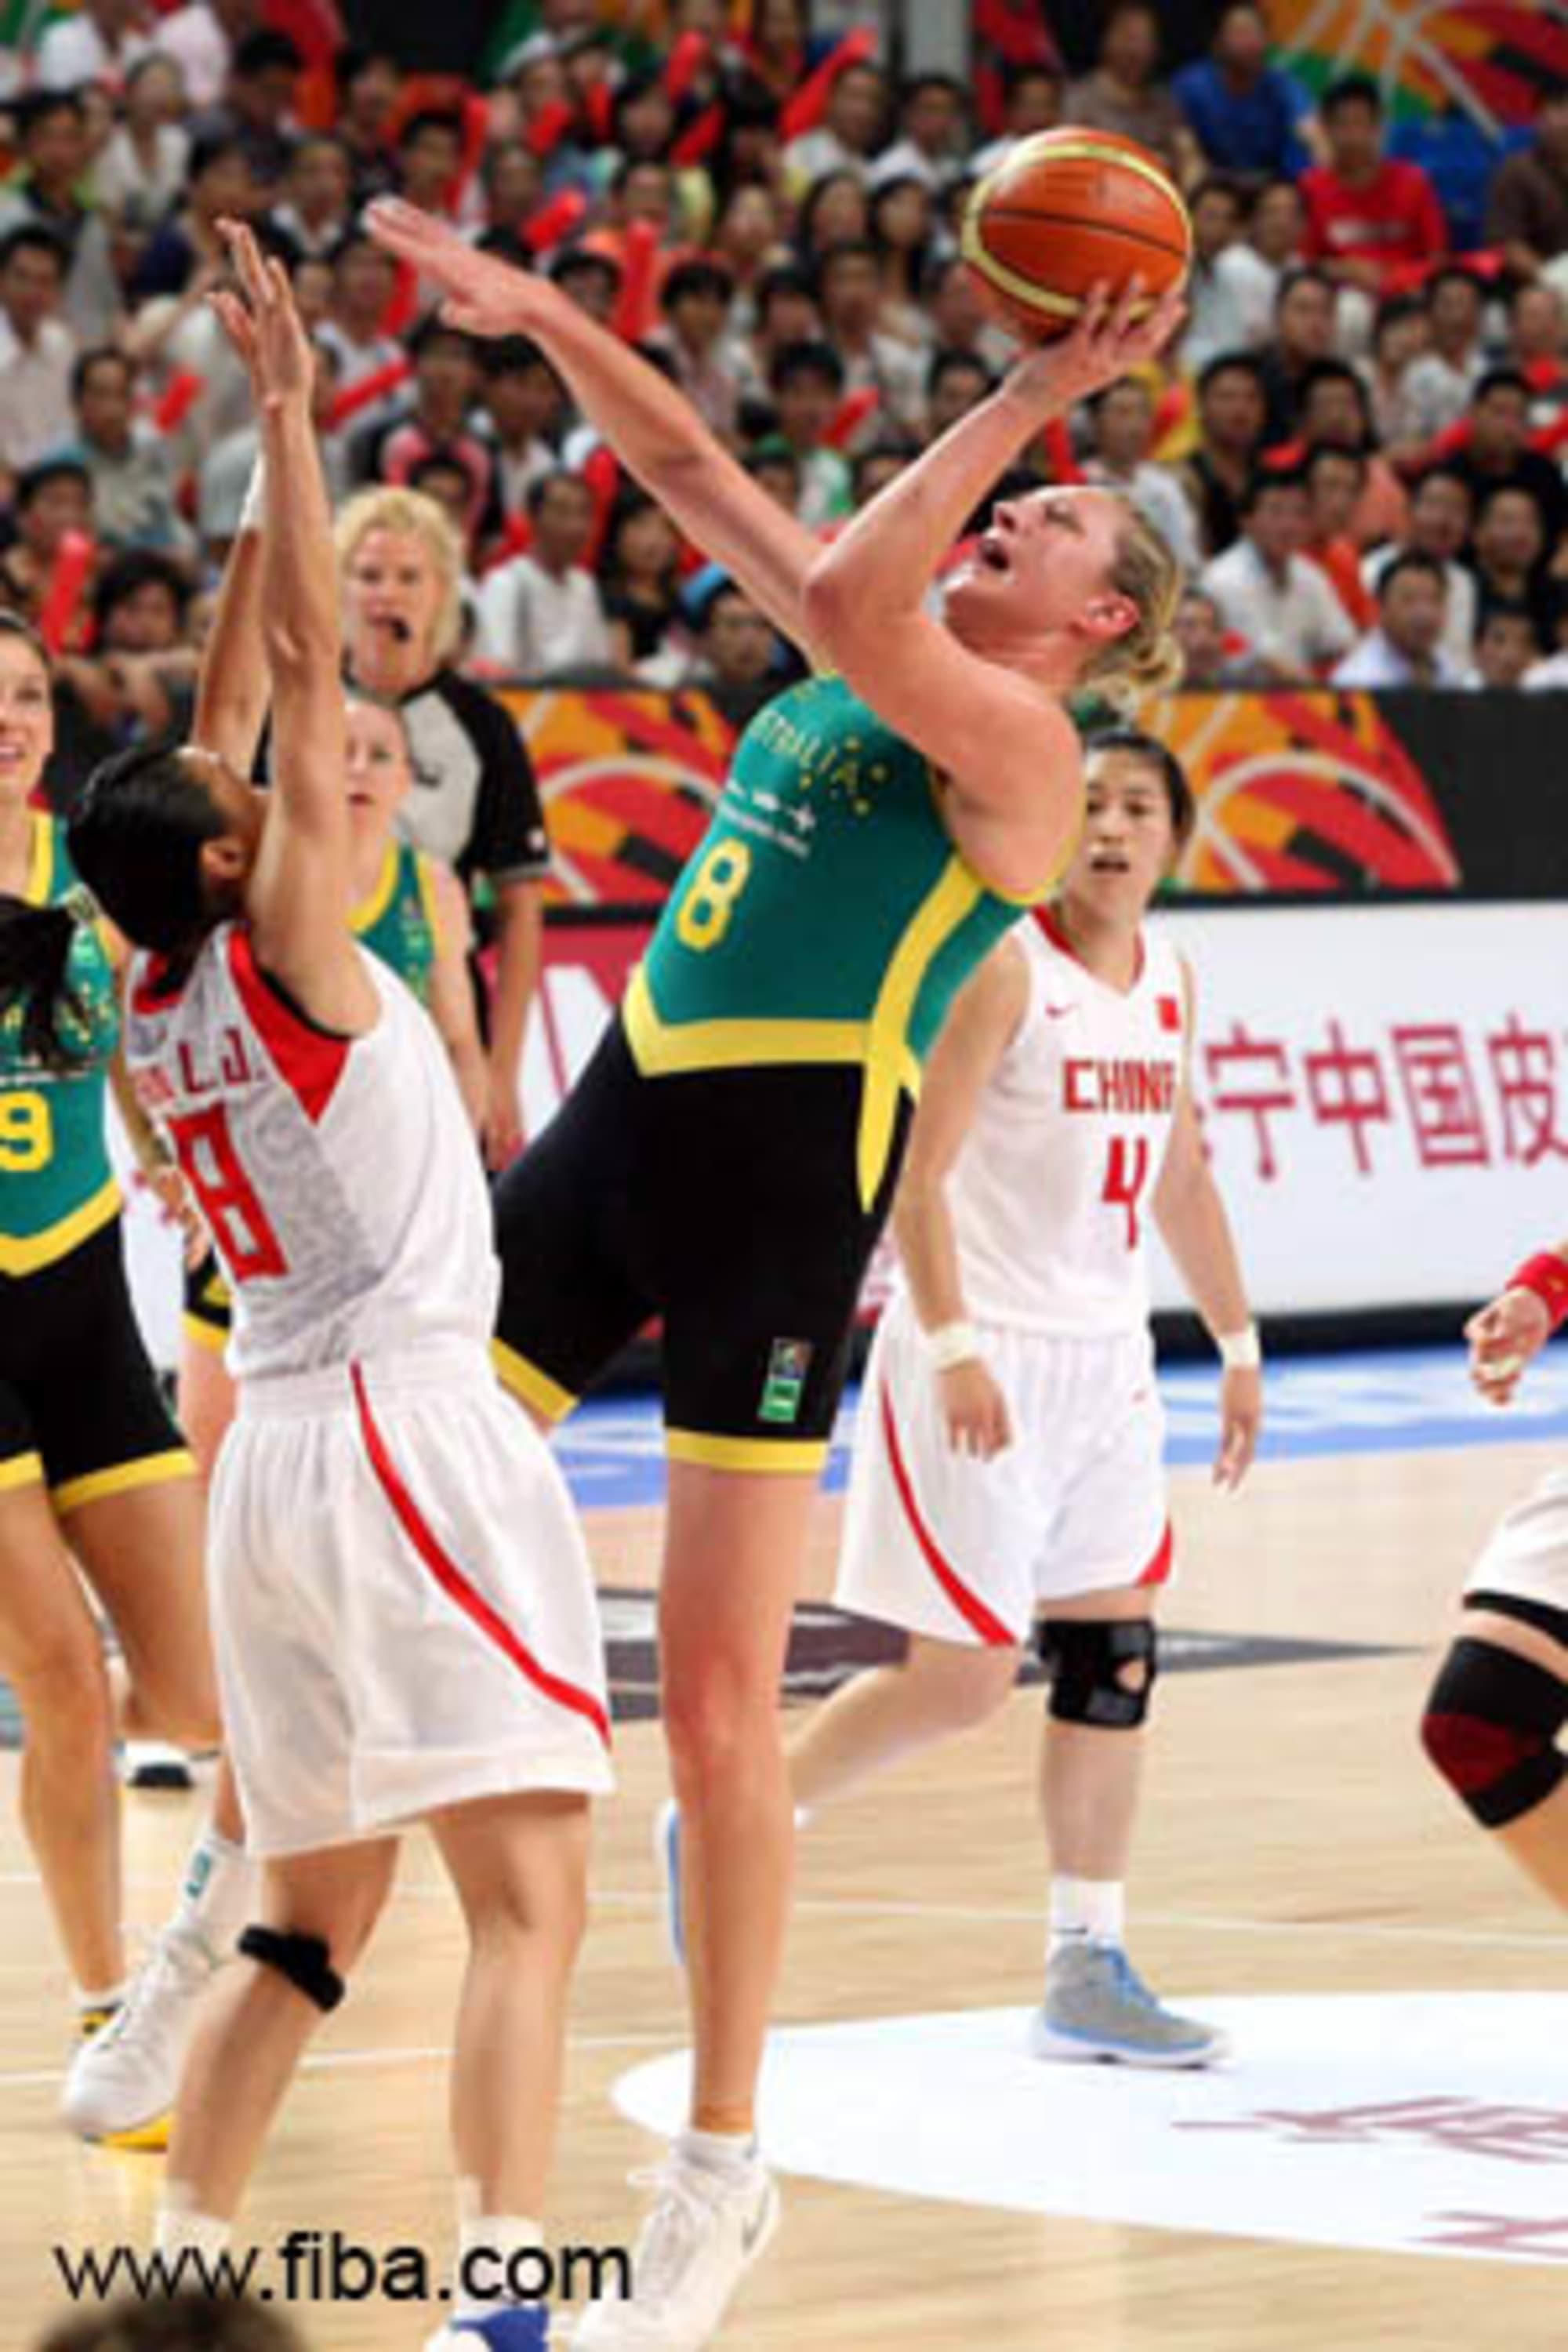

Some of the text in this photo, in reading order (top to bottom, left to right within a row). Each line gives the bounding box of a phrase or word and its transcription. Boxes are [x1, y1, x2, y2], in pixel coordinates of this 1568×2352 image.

[677, 837, 751, 949] 8
[0, 1090, 53, 1172] 9
[1193, 1010, 1568, 1180] 宁中国皮
[167, 1100, 291, 1283] 8
[1102, 1136, 1148, 1250] 4
